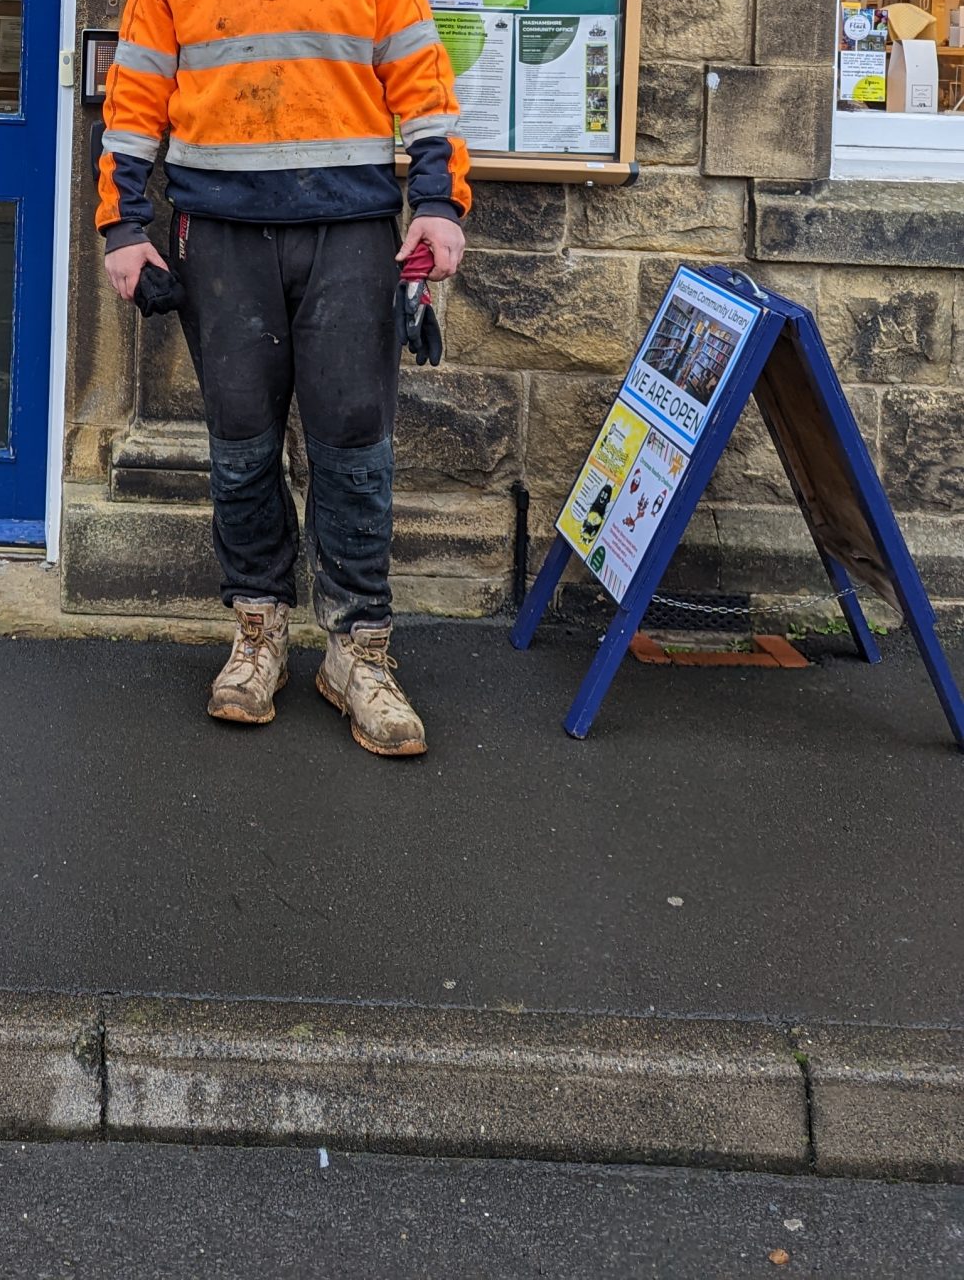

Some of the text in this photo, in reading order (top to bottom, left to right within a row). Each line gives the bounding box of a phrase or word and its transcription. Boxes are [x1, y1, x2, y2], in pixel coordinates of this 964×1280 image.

[677, 280, 750, 330] Masham Community Library
[630, 369, 705, 436] WE ARE OPEN
